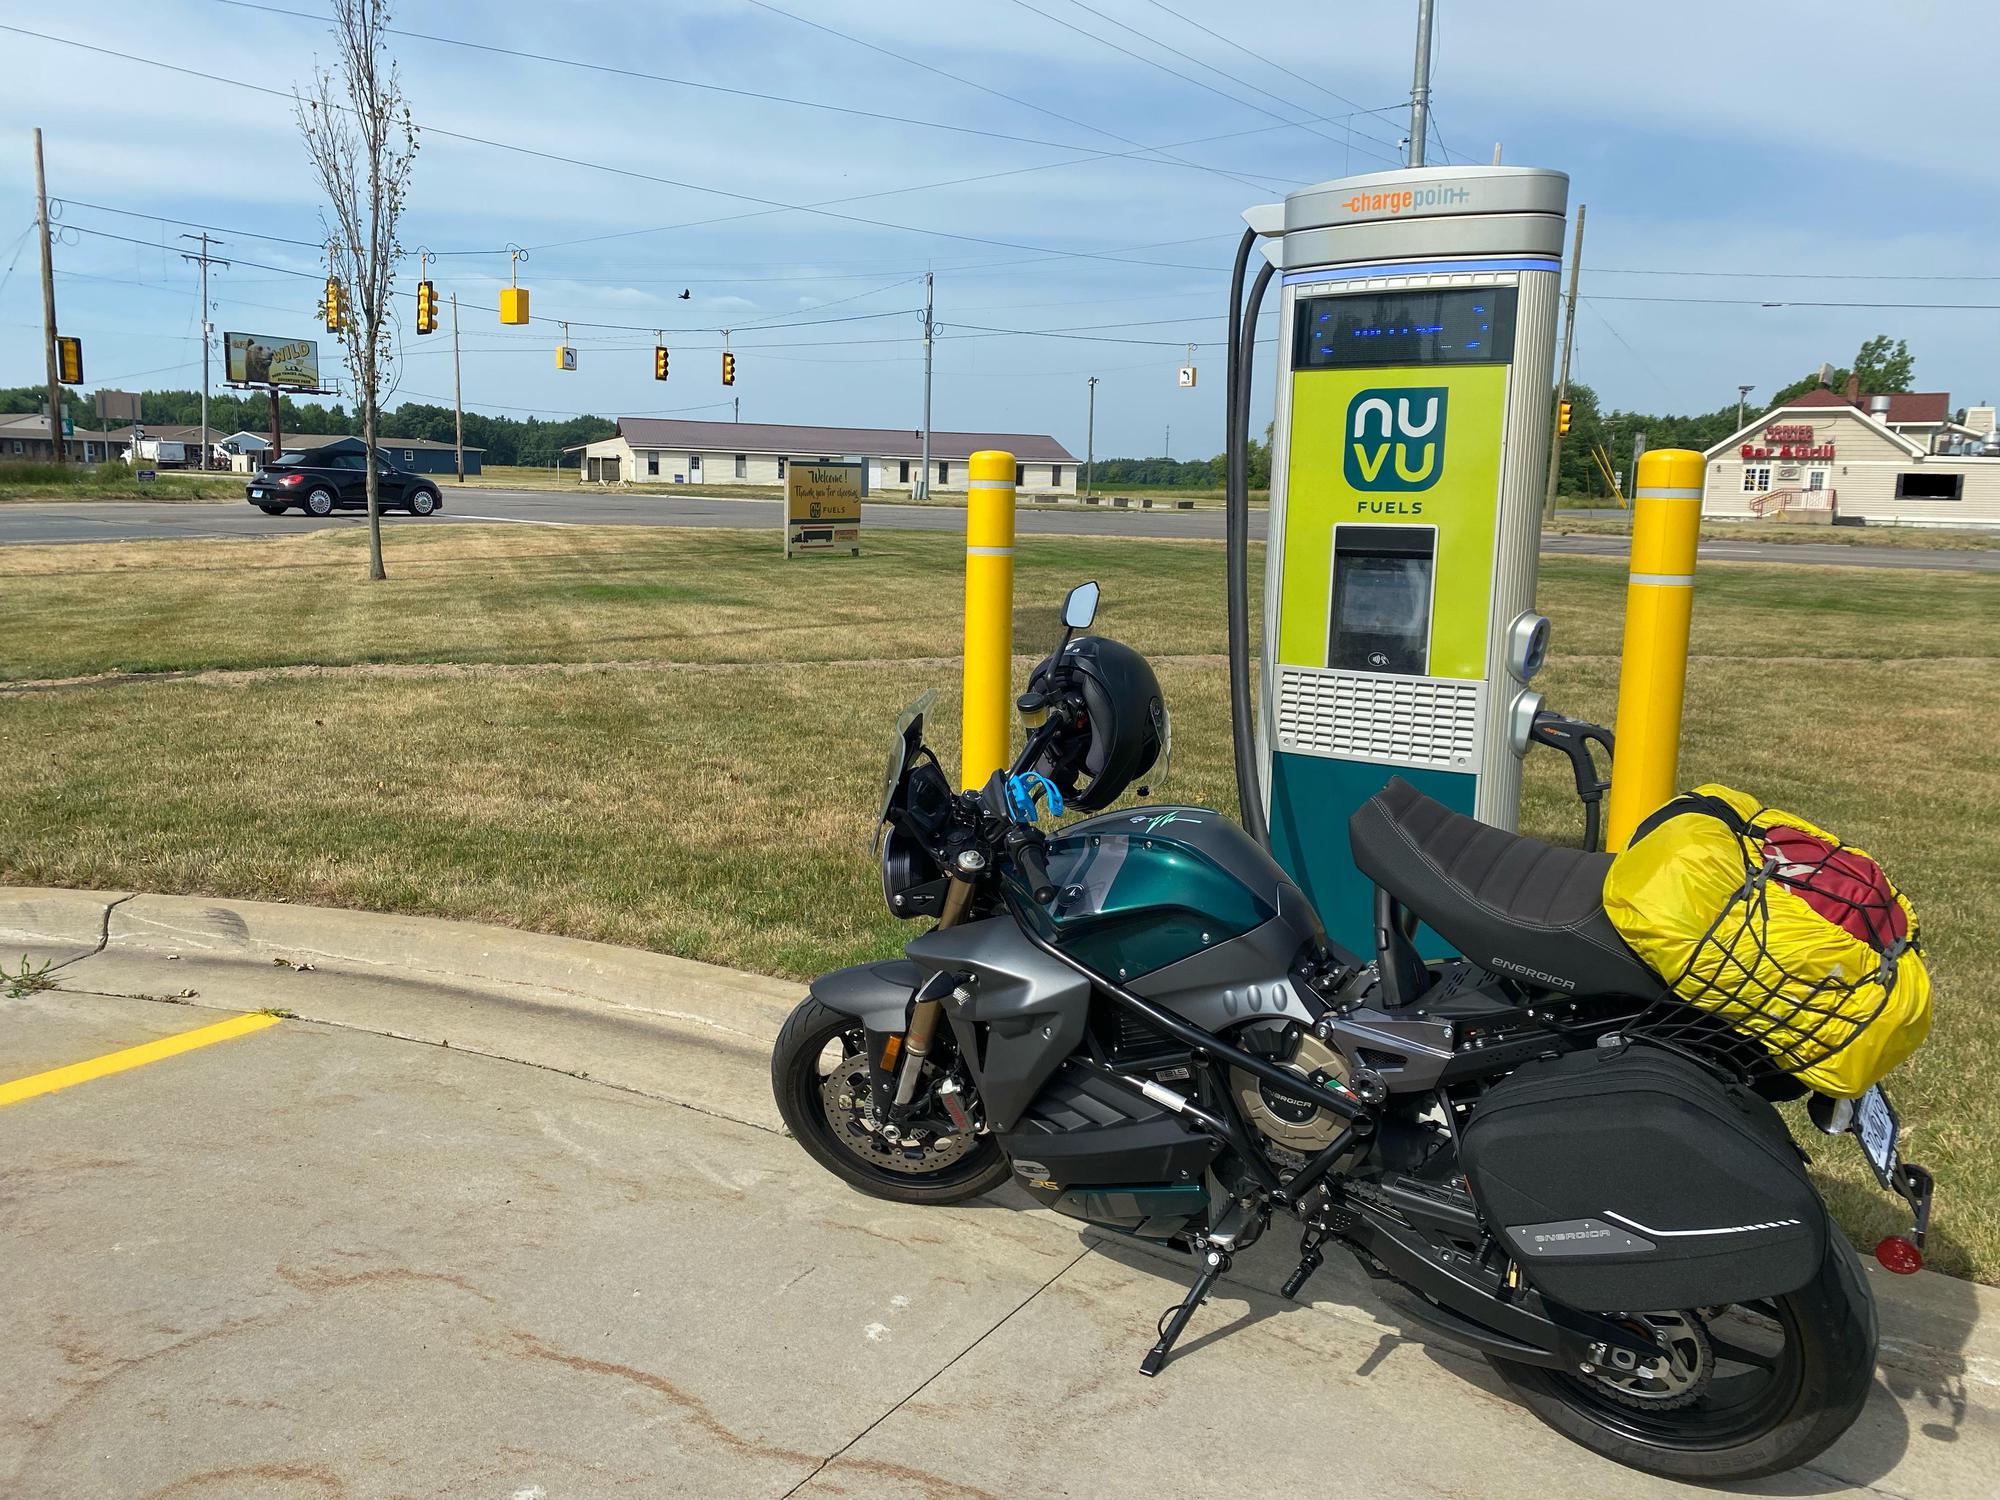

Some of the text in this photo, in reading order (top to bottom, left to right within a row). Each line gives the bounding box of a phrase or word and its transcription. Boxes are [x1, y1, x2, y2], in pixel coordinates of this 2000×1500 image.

[272, 342, 310, 363] WILD
[1766, 425, 1814, 435] CORNER
[1741, 444, 1836, 459] Bar & Grill
[808, 468, 848, 484] Welcome!
[794, 485, 814, 500] Thank
[826, 485, 836, 498] for
[837, 488, 860, 504] choosing
[823, 506, 846, 514] FUELS
[1357, 501, 1423, 515] FUELS
[1491, 957, 1577, 990] ENERGICA
[1262, 1086, 1312, 1109] ENERGICA
[1534, 1229, 1611, 1243] ENERGICA
